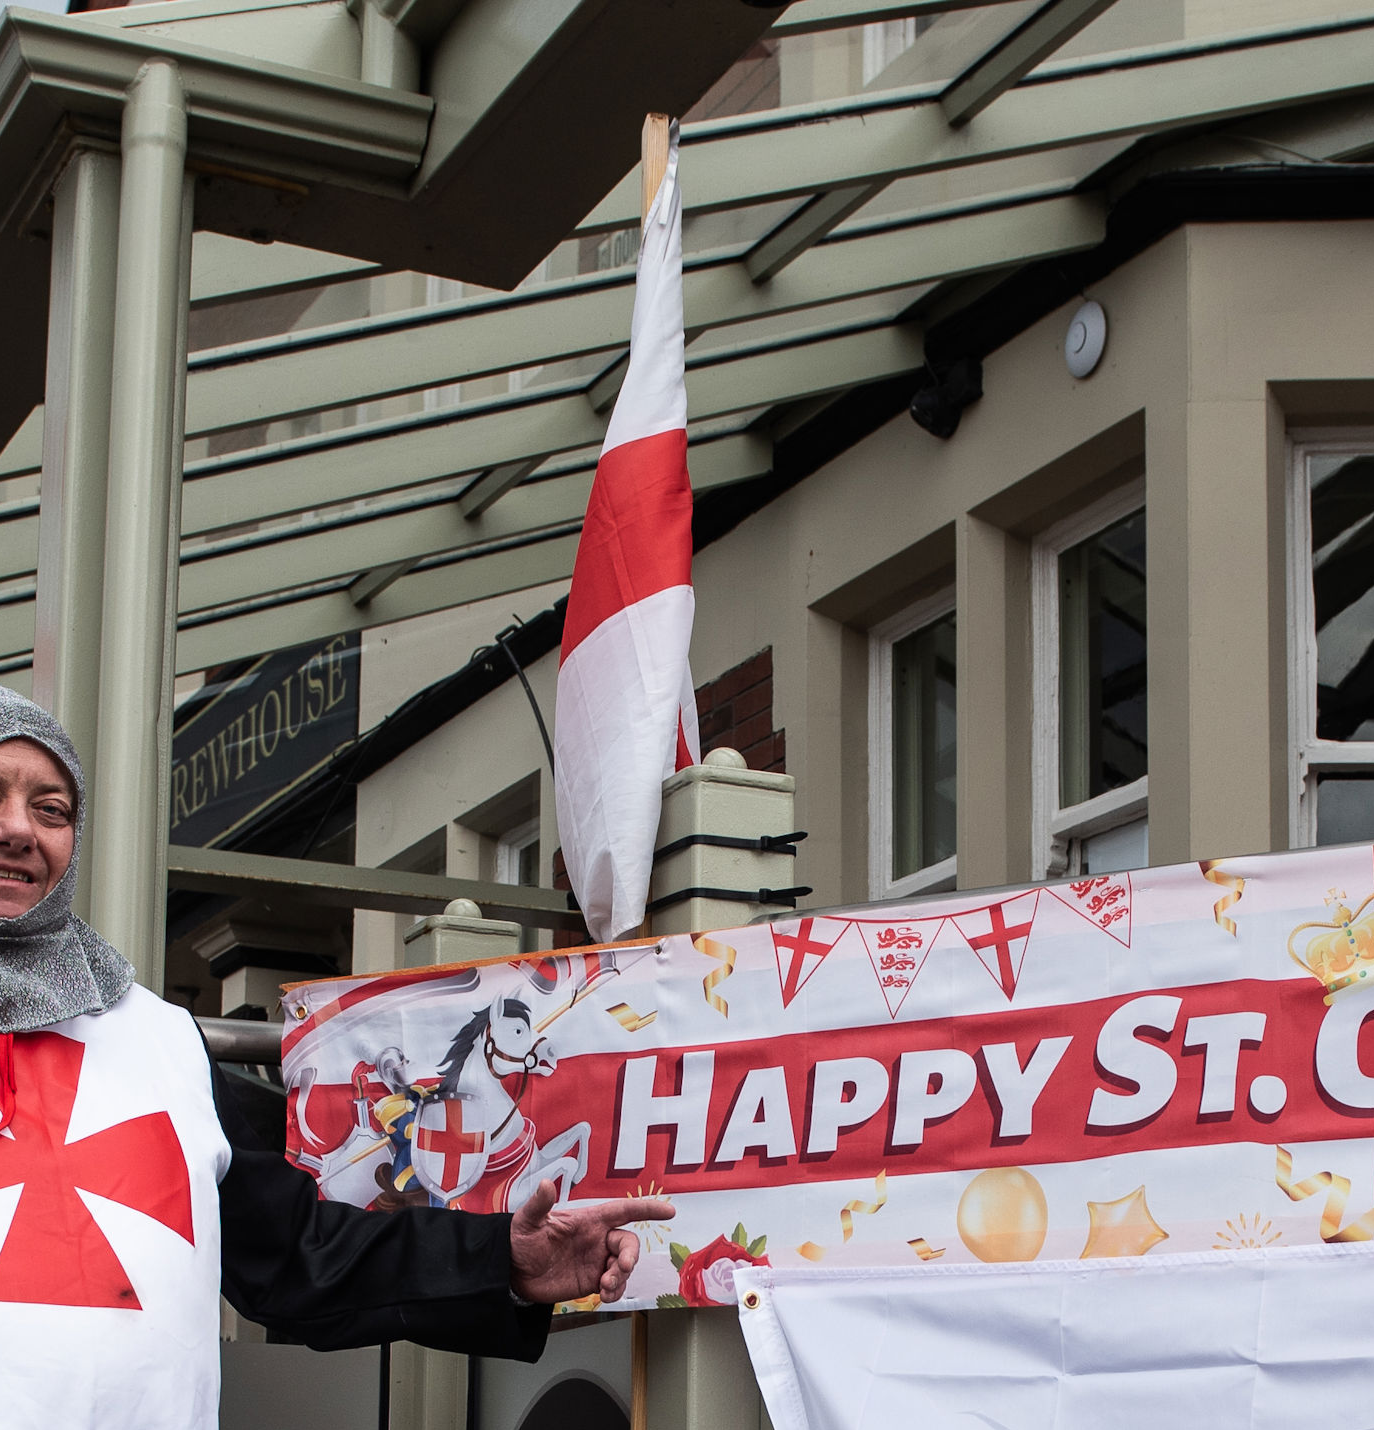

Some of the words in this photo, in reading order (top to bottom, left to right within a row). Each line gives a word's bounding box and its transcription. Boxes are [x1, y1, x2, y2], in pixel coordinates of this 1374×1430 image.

[173, 637, 346, 827] REWHOUSE
[607, 1035, 1074, 1178] HAPPY
[1084, 994, 1288, 1136] ST.
